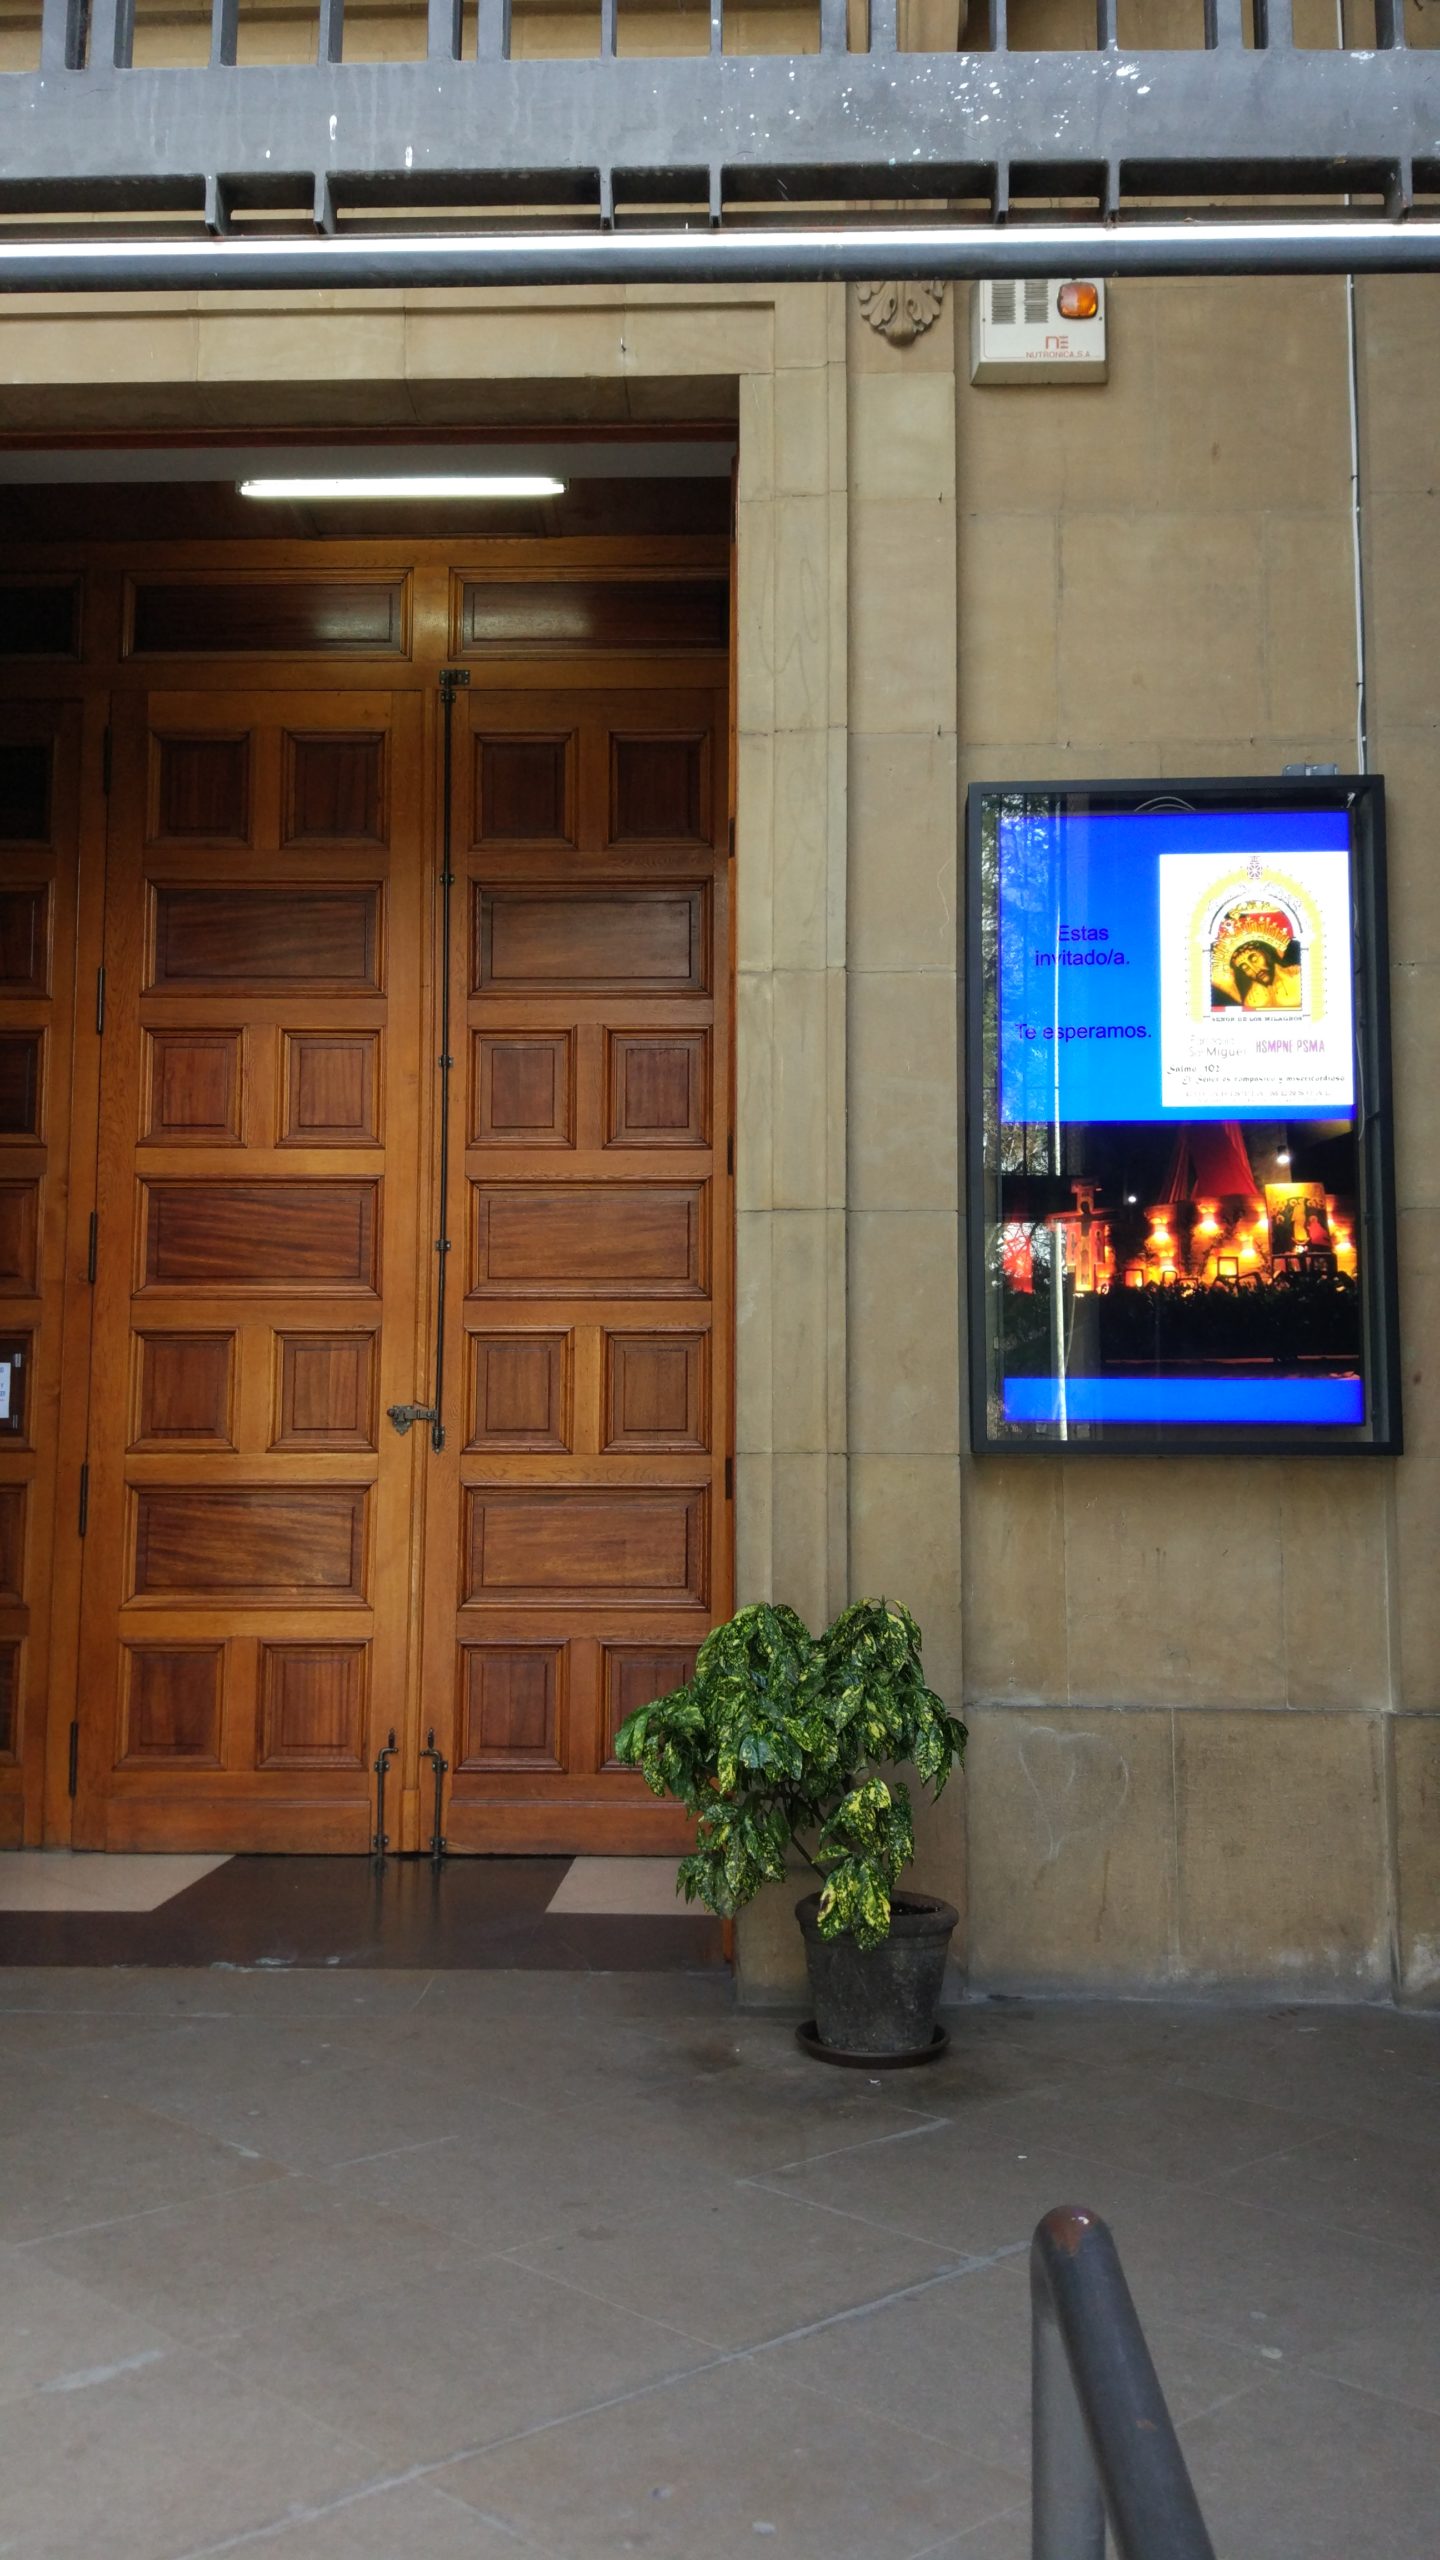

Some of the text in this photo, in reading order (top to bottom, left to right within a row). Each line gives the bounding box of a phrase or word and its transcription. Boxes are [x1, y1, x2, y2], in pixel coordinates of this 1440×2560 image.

[1058, 925, 1109, 941] Estas
[1035, 949, 1130, 966] invitado/a.
[1015, 1023, 1152, 1042] Te esperamos.
[1296, 1039, 1325, 1054] PSMA
